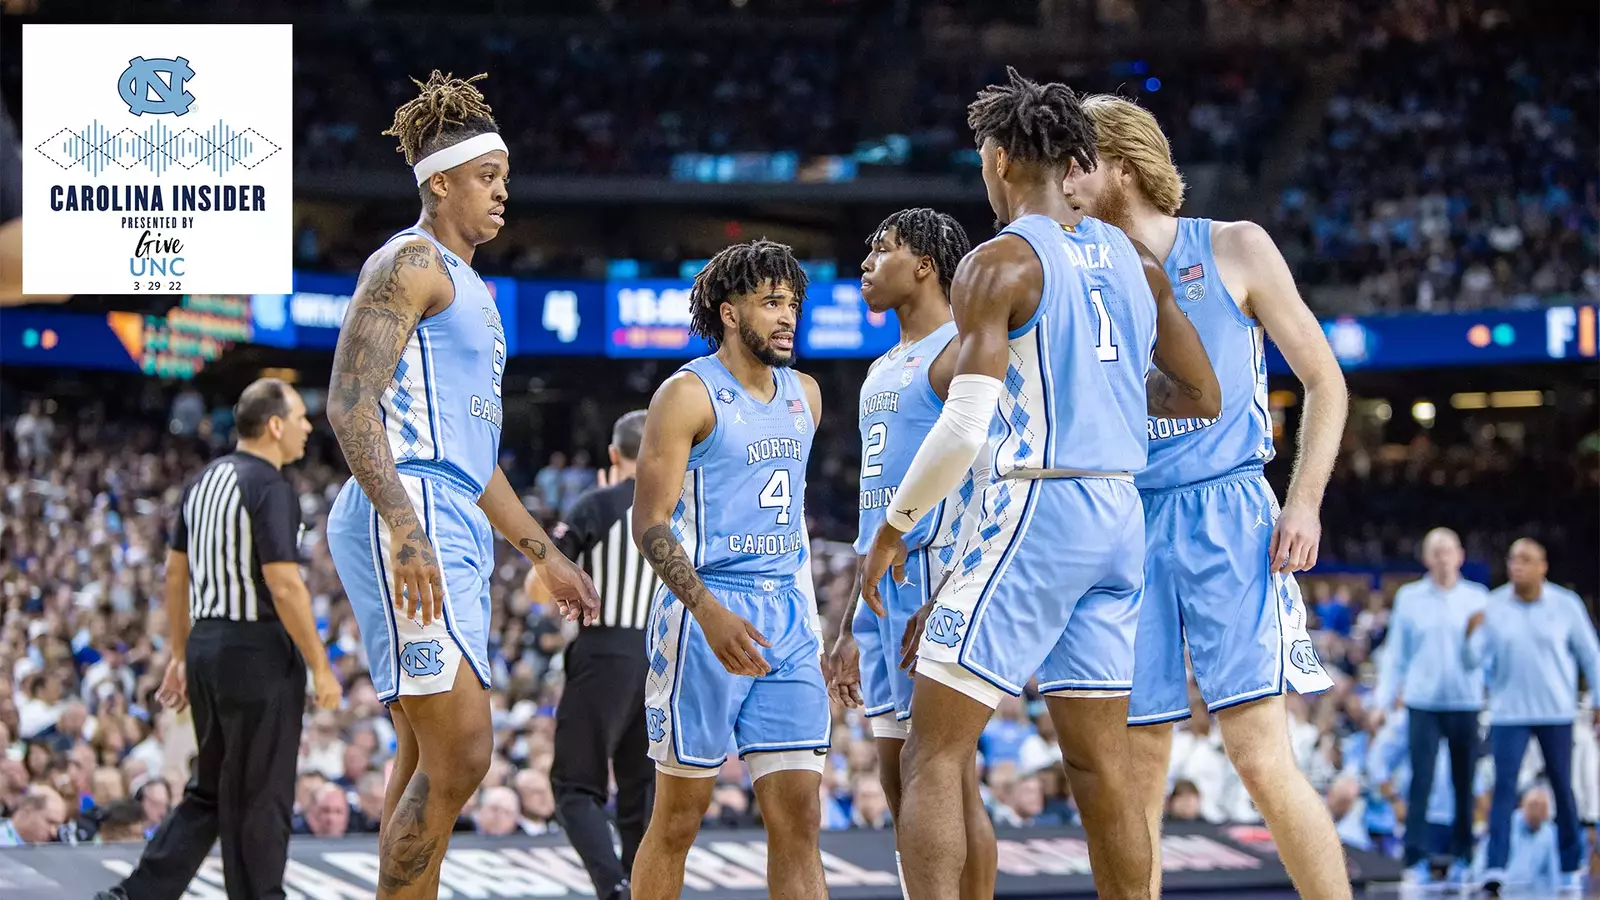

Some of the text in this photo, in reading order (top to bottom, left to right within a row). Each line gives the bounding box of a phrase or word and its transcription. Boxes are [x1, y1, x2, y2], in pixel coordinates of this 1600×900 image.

[1090, 288, 1119, 363] 1
[862, 390, 900, 421] NORTH
[747, 438, 803, 466] NORTH
[862, 422, 887, 479] 2
[758, 469, 792, 526] 4
